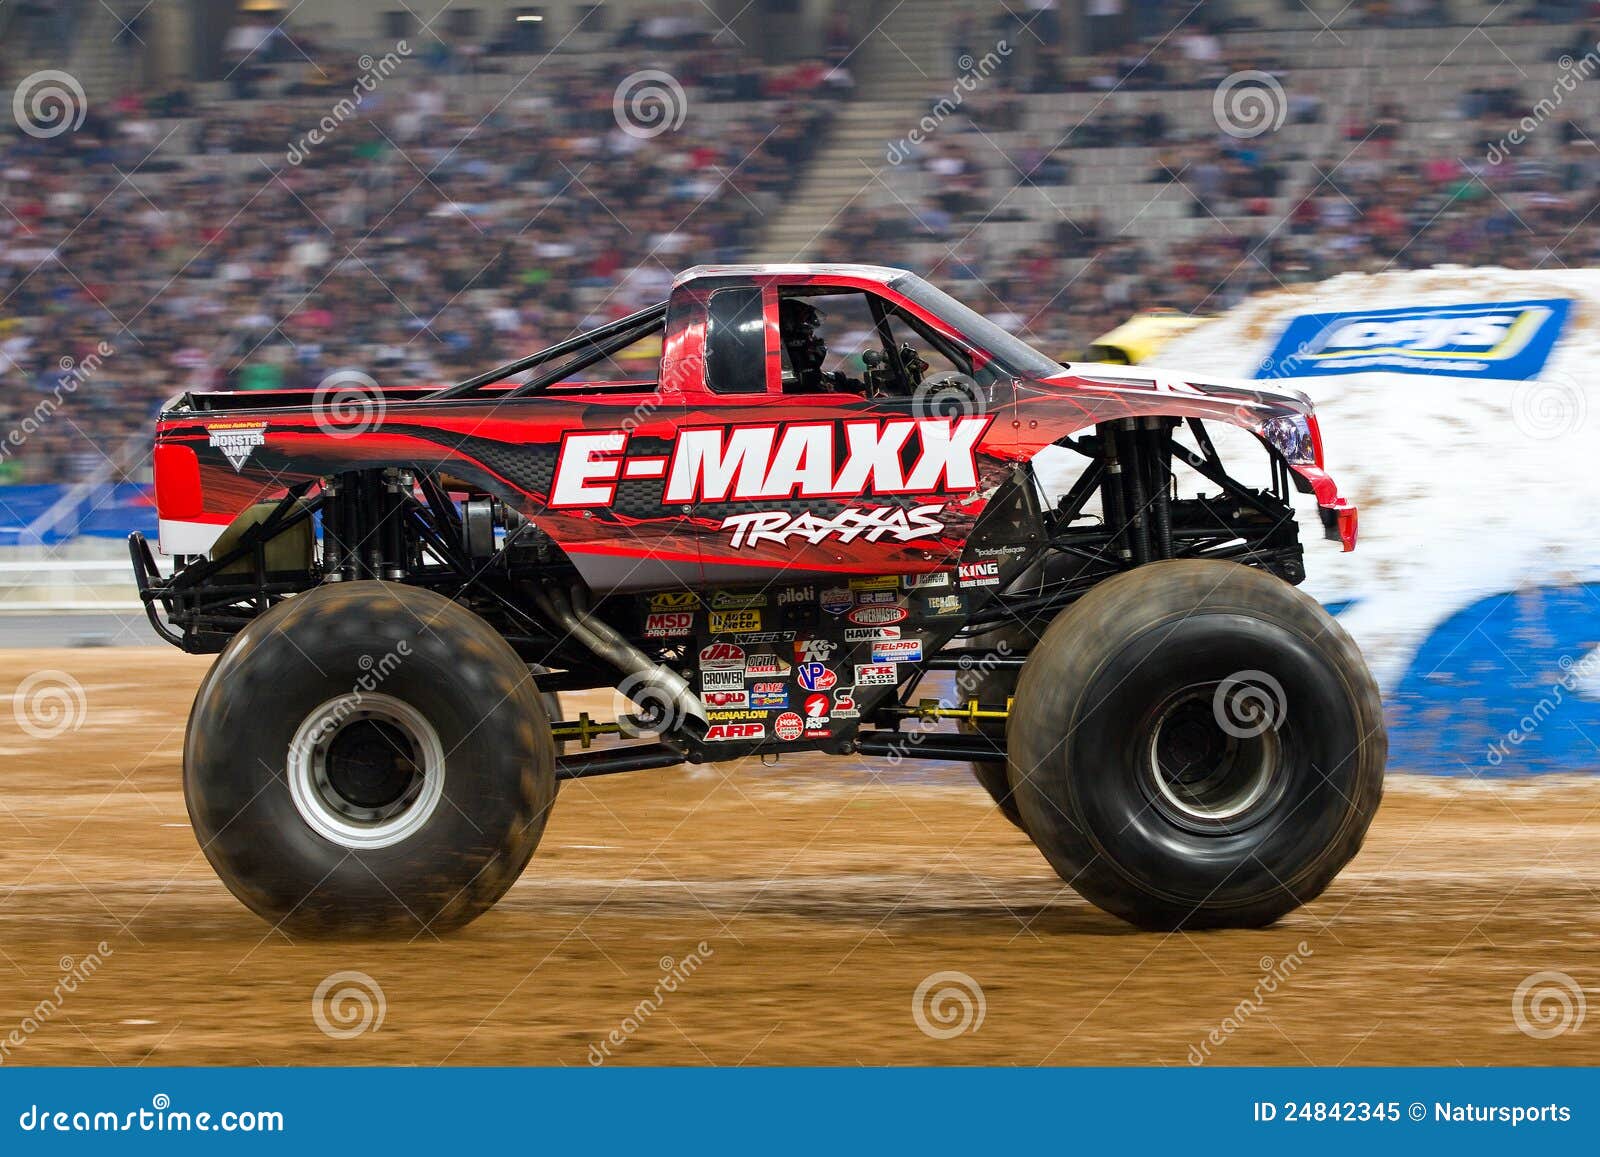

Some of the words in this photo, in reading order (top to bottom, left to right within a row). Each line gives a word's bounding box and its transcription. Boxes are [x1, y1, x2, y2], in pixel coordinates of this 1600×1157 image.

[209, 434, 265, 447] MONSTER
[223, 446, 252, 457] JAM
[550, 417, 994, 508] E-MAXX
[721, 504, 946, 549] TRAXXAS
[958, 563, 998, 578] KING
[777, 586, 816, 606] piloti
[648, 613, 691, 629] MSD
[854, 607, 902, 623] POWERMASTER
[846, 629, 881, 639] HAWK
[701, 644, 744, 660] JAZ
[704, 671, 743, 685] CROWER
[799, 662, 825, 691] VP
[705, 691, 745, 705] WORLD
[706, 724, 764, 739] ARP
